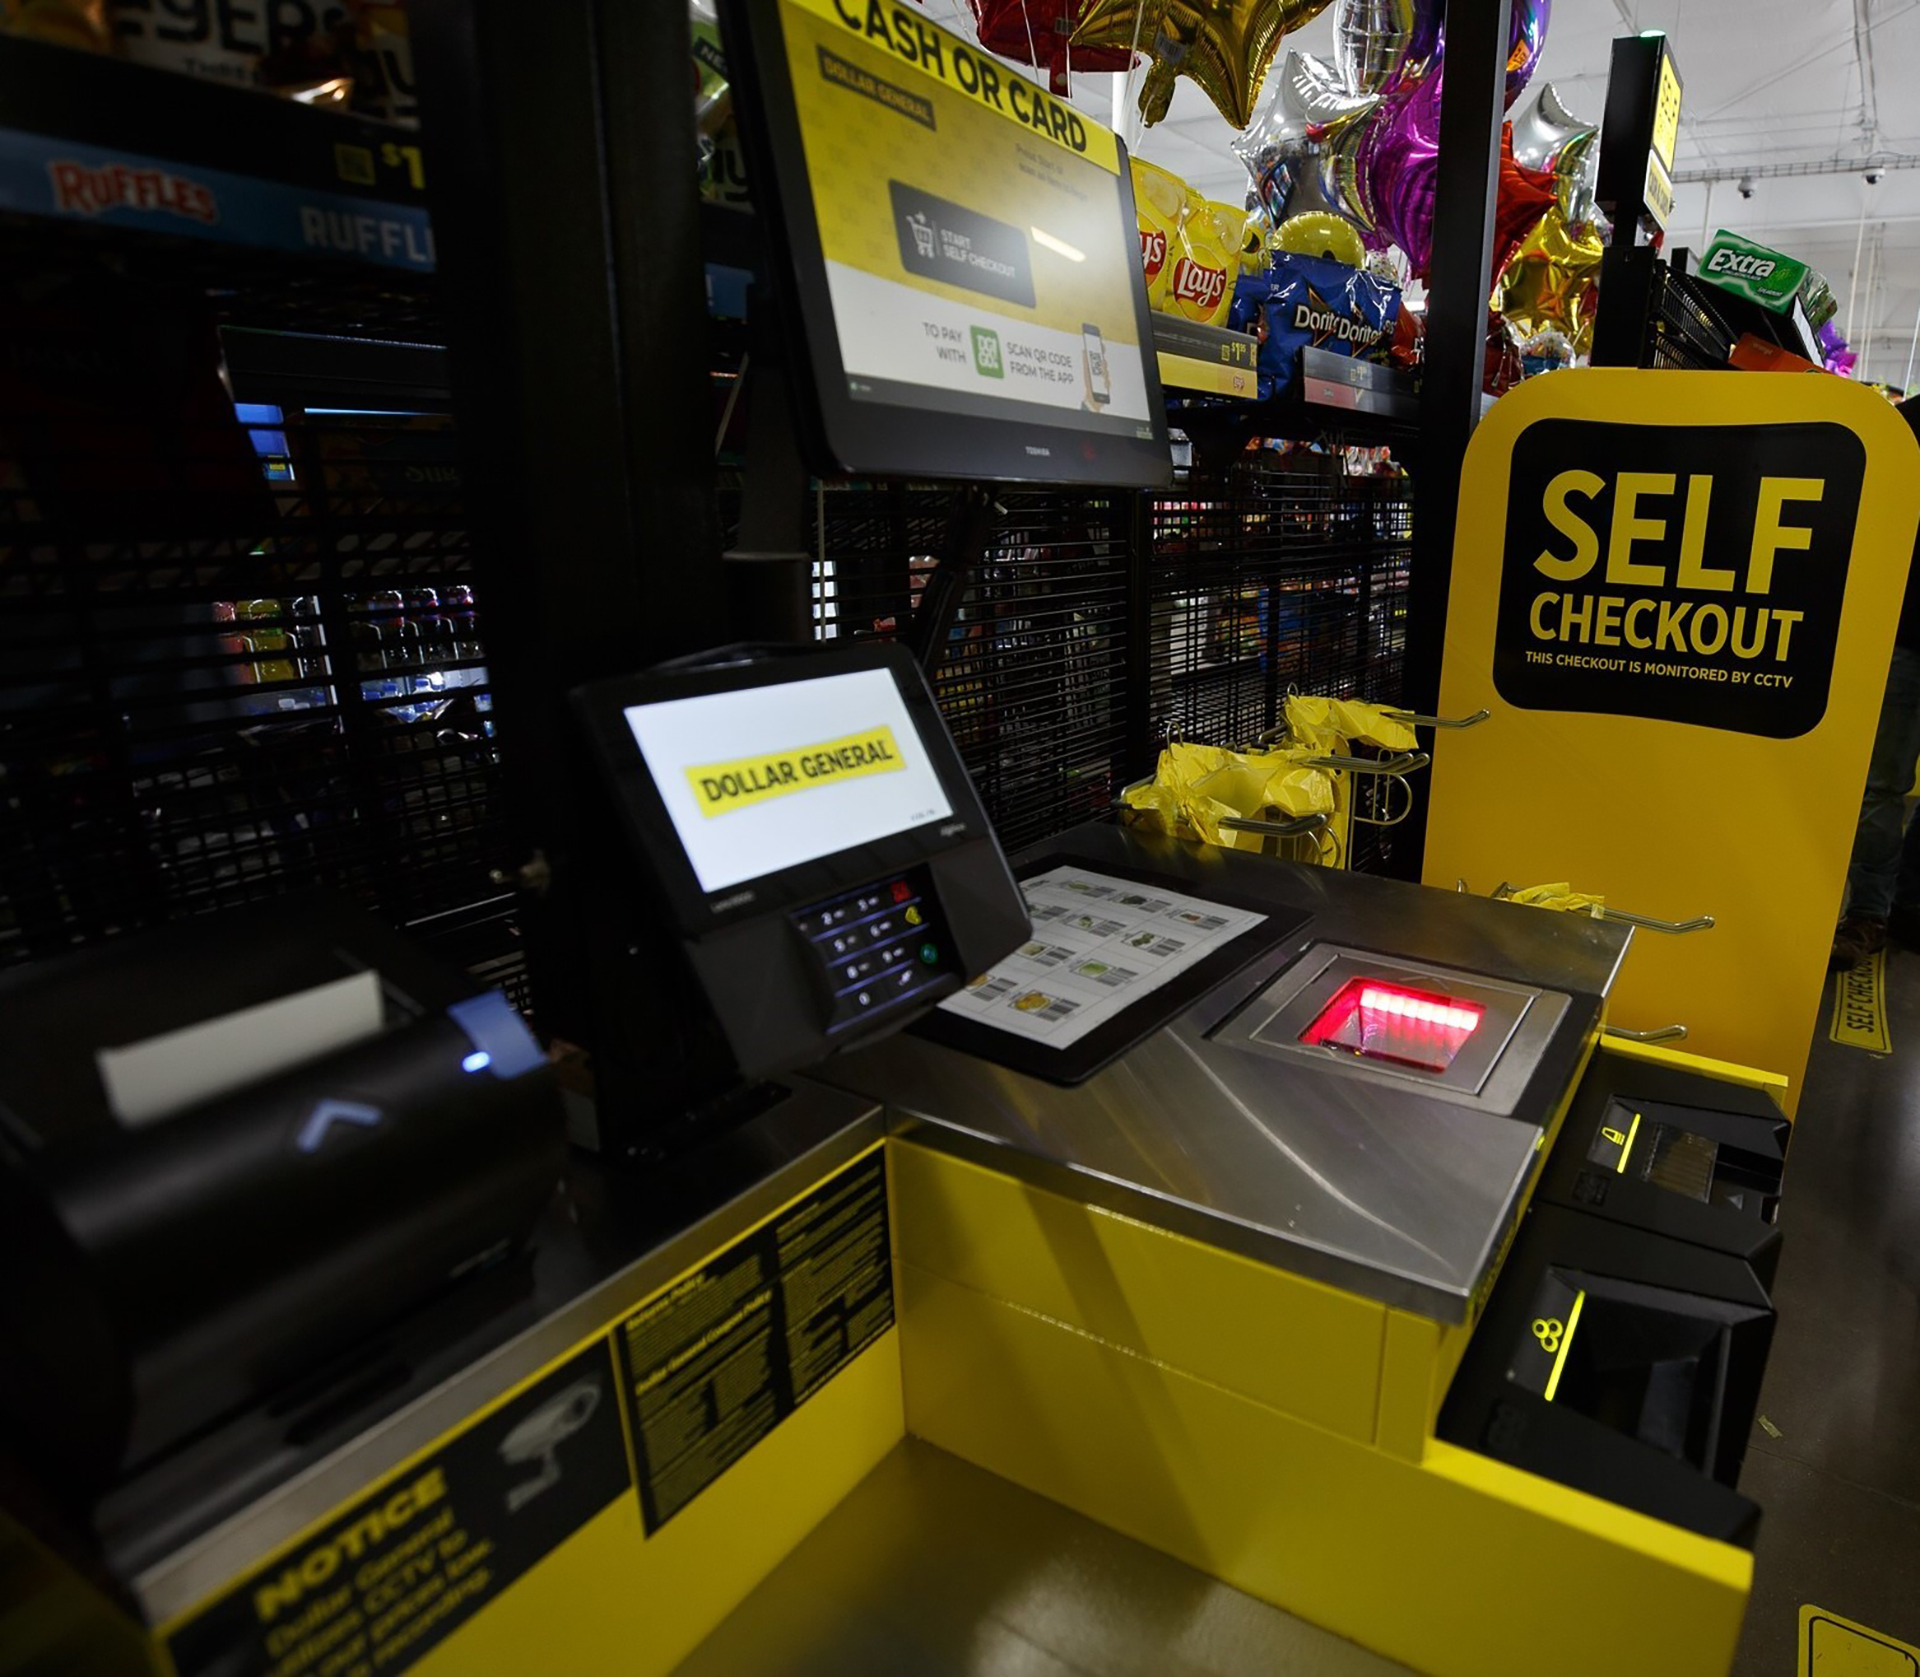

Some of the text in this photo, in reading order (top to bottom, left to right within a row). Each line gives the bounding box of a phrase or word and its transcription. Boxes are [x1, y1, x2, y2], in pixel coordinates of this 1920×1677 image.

[835, 0, 1087, 152] CASH OR CARD
[49, 162, 218, 225] RUFFLES
[940, 229, 972, 250] START
[943, 244, 1015, 277] SELF CHECKOUT
[1177, 258, 1225, 307] Lay's
[1707, 248, 1776, 278] Extra
[922, 321, 963, 343] TO PAY
[936, 346, 967, 364] WITH
[1006, 342, 1033, 359] SCAN
[1033, 348, 1047, 363] QR
[1047, 351, 1073, 368] CODE
[1010, 361, 1075, 385] FROM THE APP
[1532, 468, 1825, 595] SELF
[1529, 591, 1804, 662] CHECKOUT
[1525, 651, 1793, 689] THIS CHECKOUT IS MONITORED BY CCTV
[701, 740, 894, 803] DOLLAR GENERAL
[1846, 1002, 1875, 1033] SELF
[256, 1466, 446, 1623] NOTICE
[355, 1504, 455, 1590] General
[363, 1549, 436, 1614] CCTV
[437, 1529, 468, 1559] to
